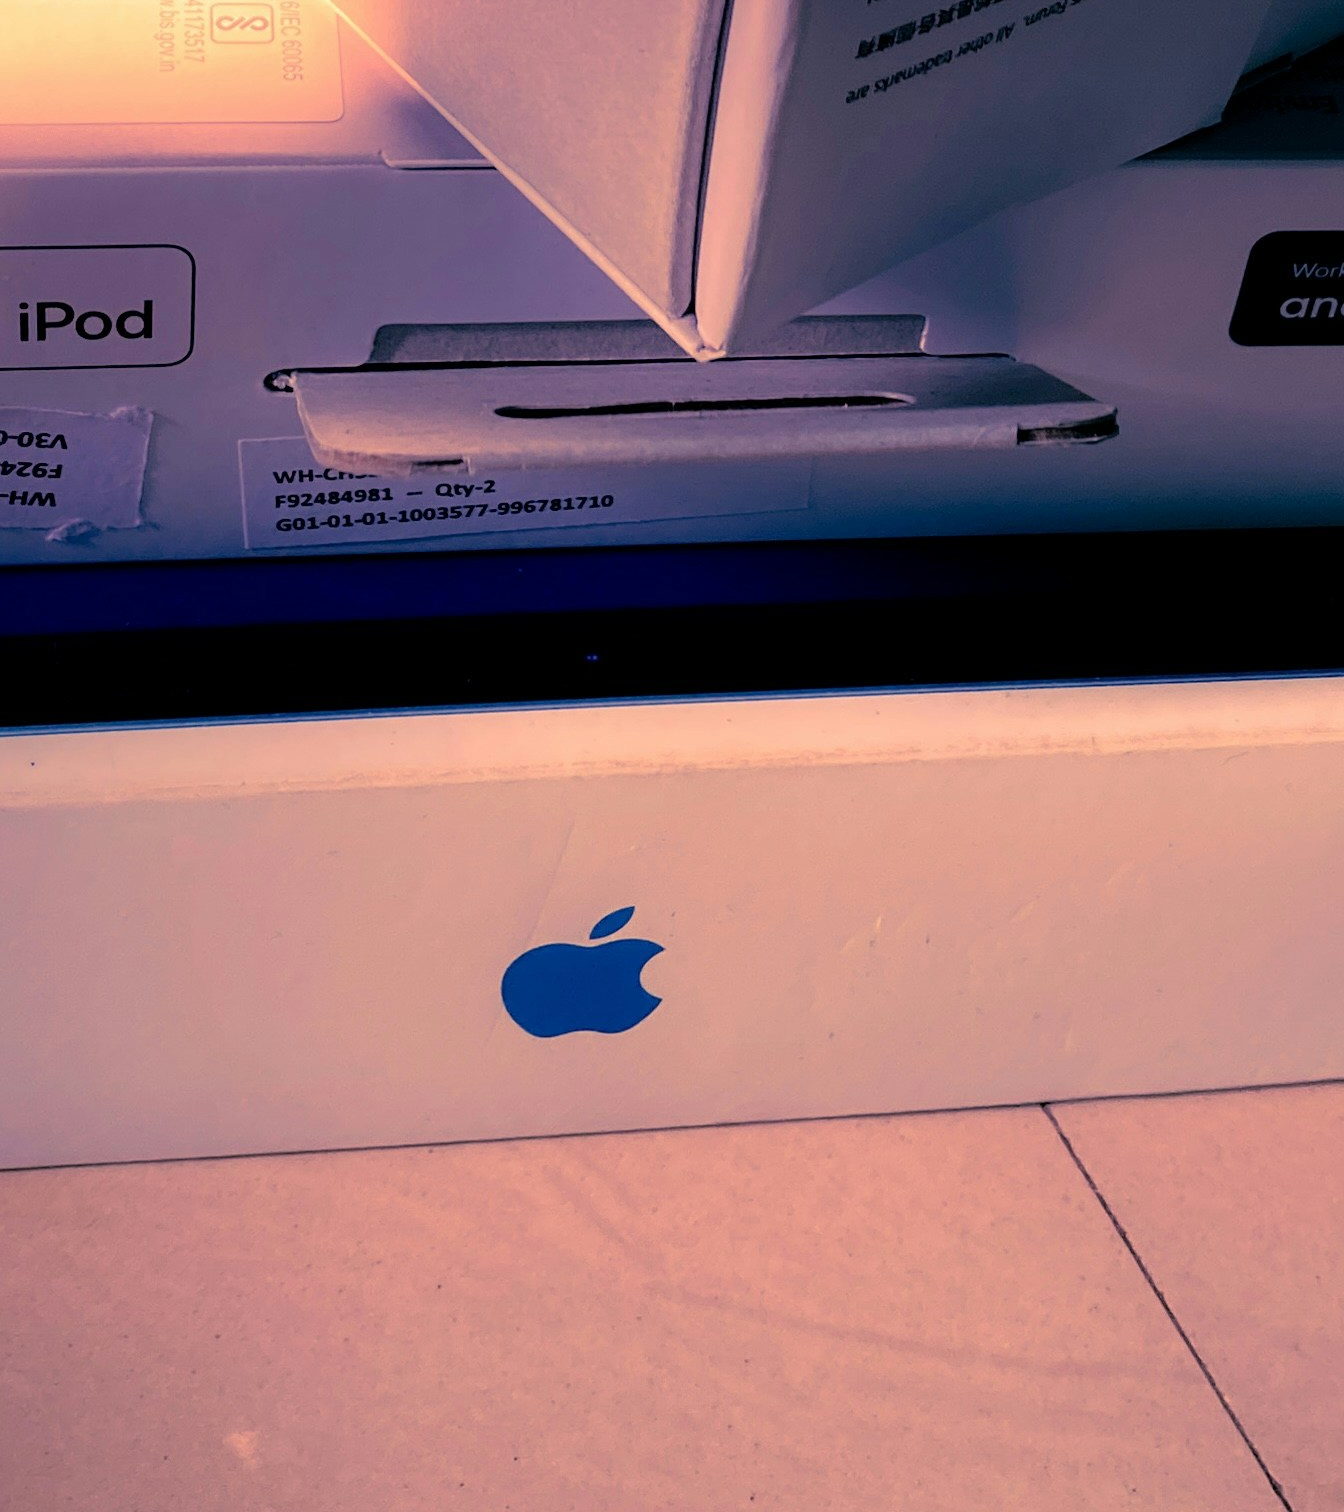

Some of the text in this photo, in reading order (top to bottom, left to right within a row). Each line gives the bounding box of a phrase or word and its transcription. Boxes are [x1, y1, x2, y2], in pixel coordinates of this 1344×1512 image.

[955, 32, 994, 58] other
[995, 22, 1015, 41] All
[282, 40, 303, 81] 60065
[874, 49, 953, 92] trademarks
[845, 84, 870, 105] are
[19, 299, 154, 341] iPod
[275, 487, 394, 509] F92484981
[435, 480, 497, 499] Qty-2
[275, 494, 615, 532] G01-01-01-1003577-996781710
